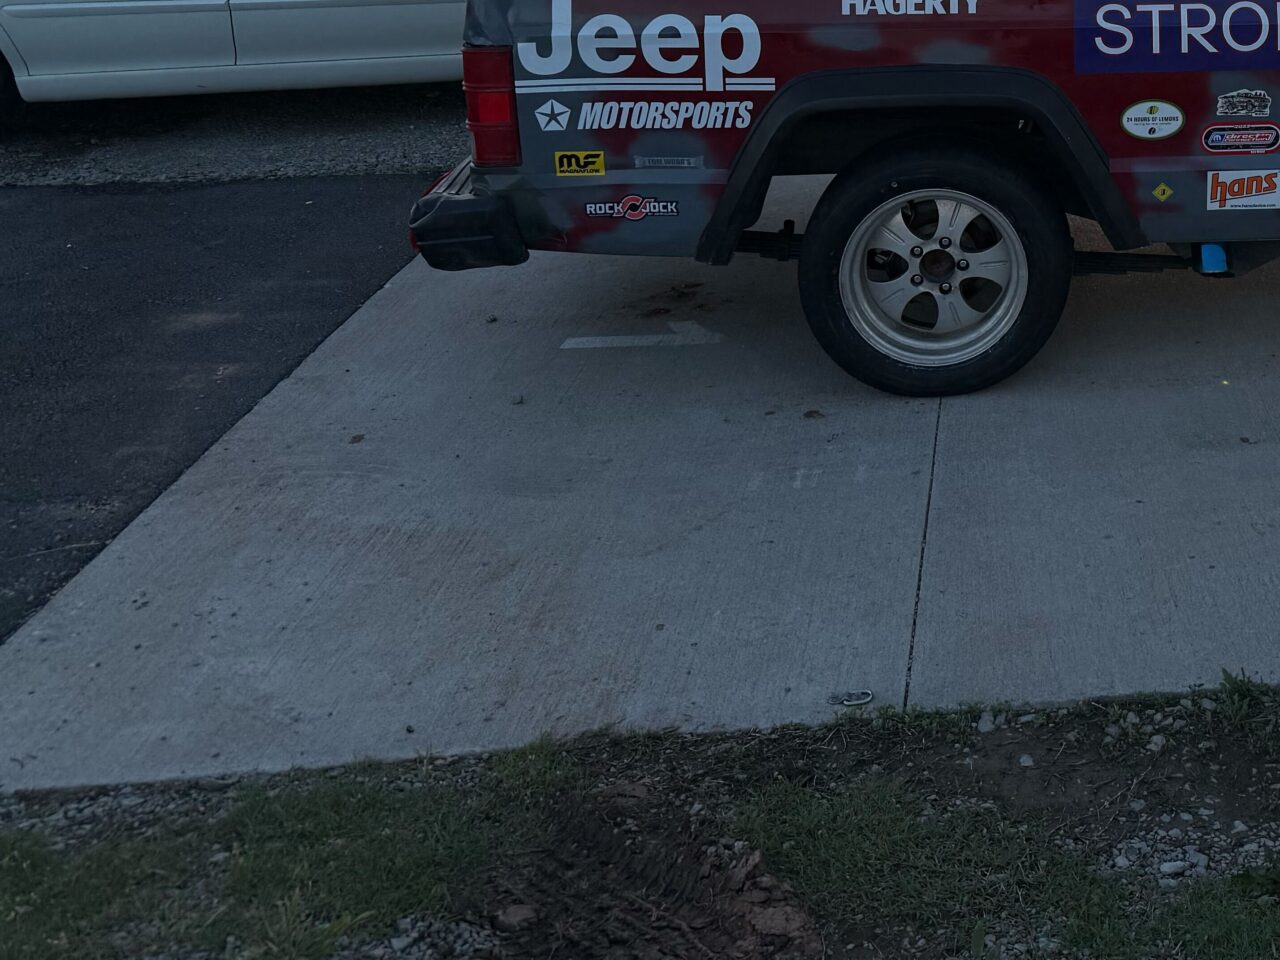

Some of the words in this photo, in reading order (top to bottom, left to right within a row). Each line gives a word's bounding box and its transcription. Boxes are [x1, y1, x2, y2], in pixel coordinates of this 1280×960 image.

[577, 101, 753, 130] MOTORSPORTS
[1211, 173, 1278, 208] hans
[586, 203, 622, 215] ROCK
[642, 201, 678, 213] JOCK
